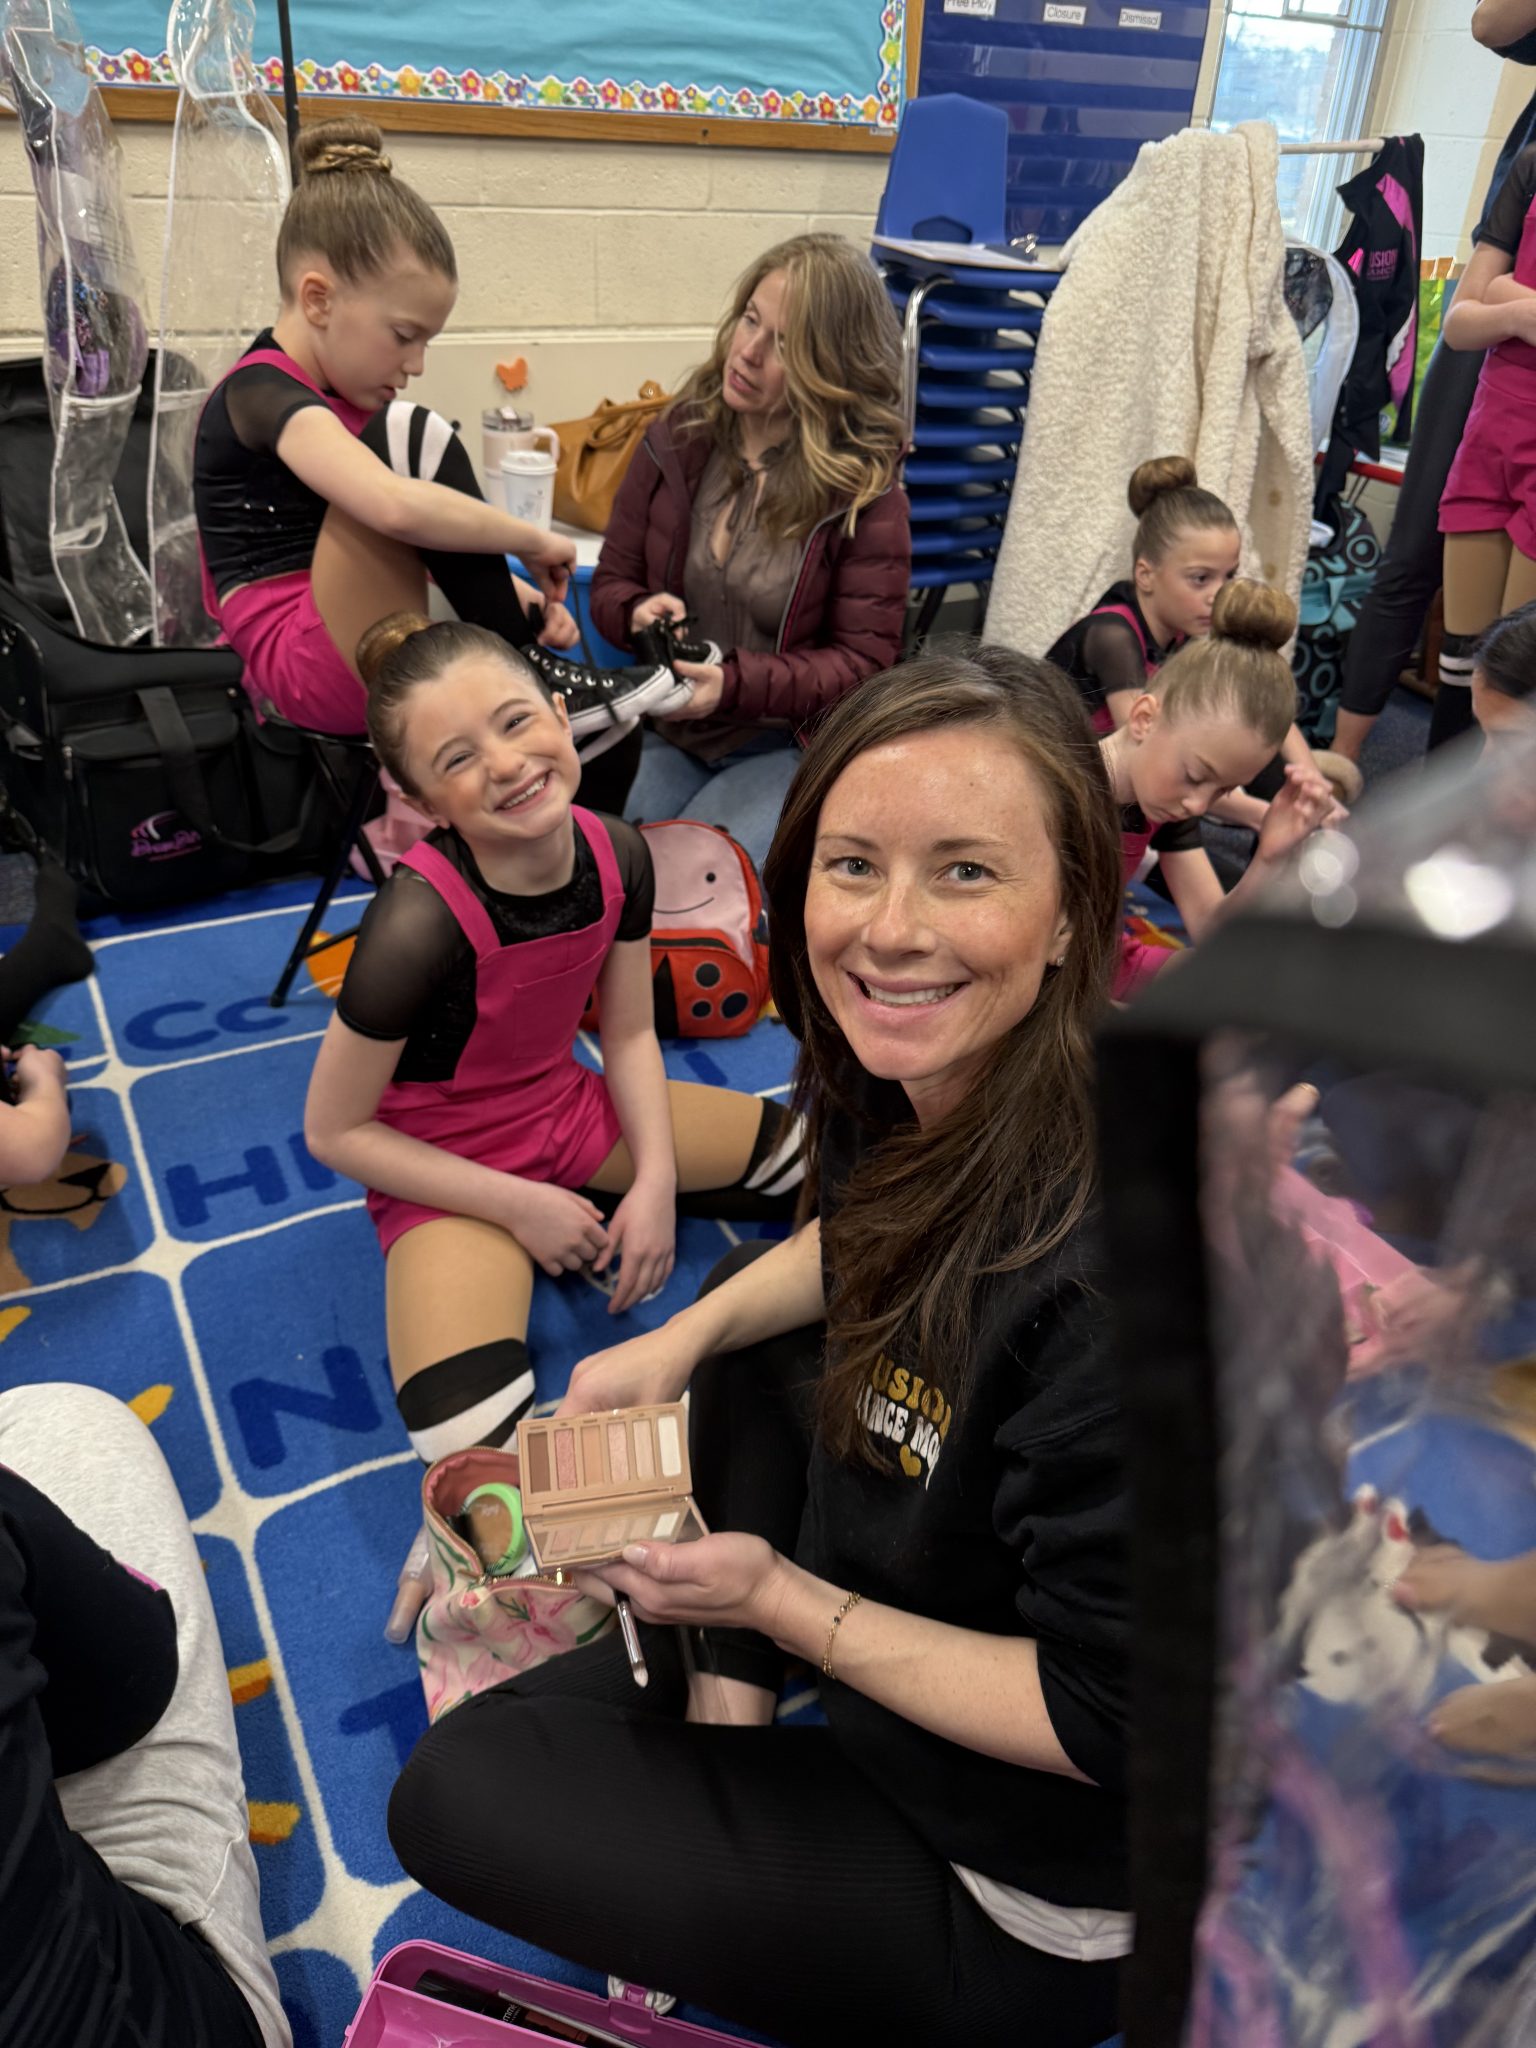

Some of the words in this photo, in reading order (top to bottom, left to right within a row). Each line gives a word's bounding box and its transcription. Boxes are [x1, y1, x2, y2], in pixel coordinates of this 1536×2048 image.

[945, 0, 969, 8] Free
[971, 0, 992, 11] Play
[1047, 6, 1082, 20] Closure
[1120, 11, 1159, 26] Dismissal
[1368, 249, 1398, 267] USION
[124, 996, 290, 1050] Cc
